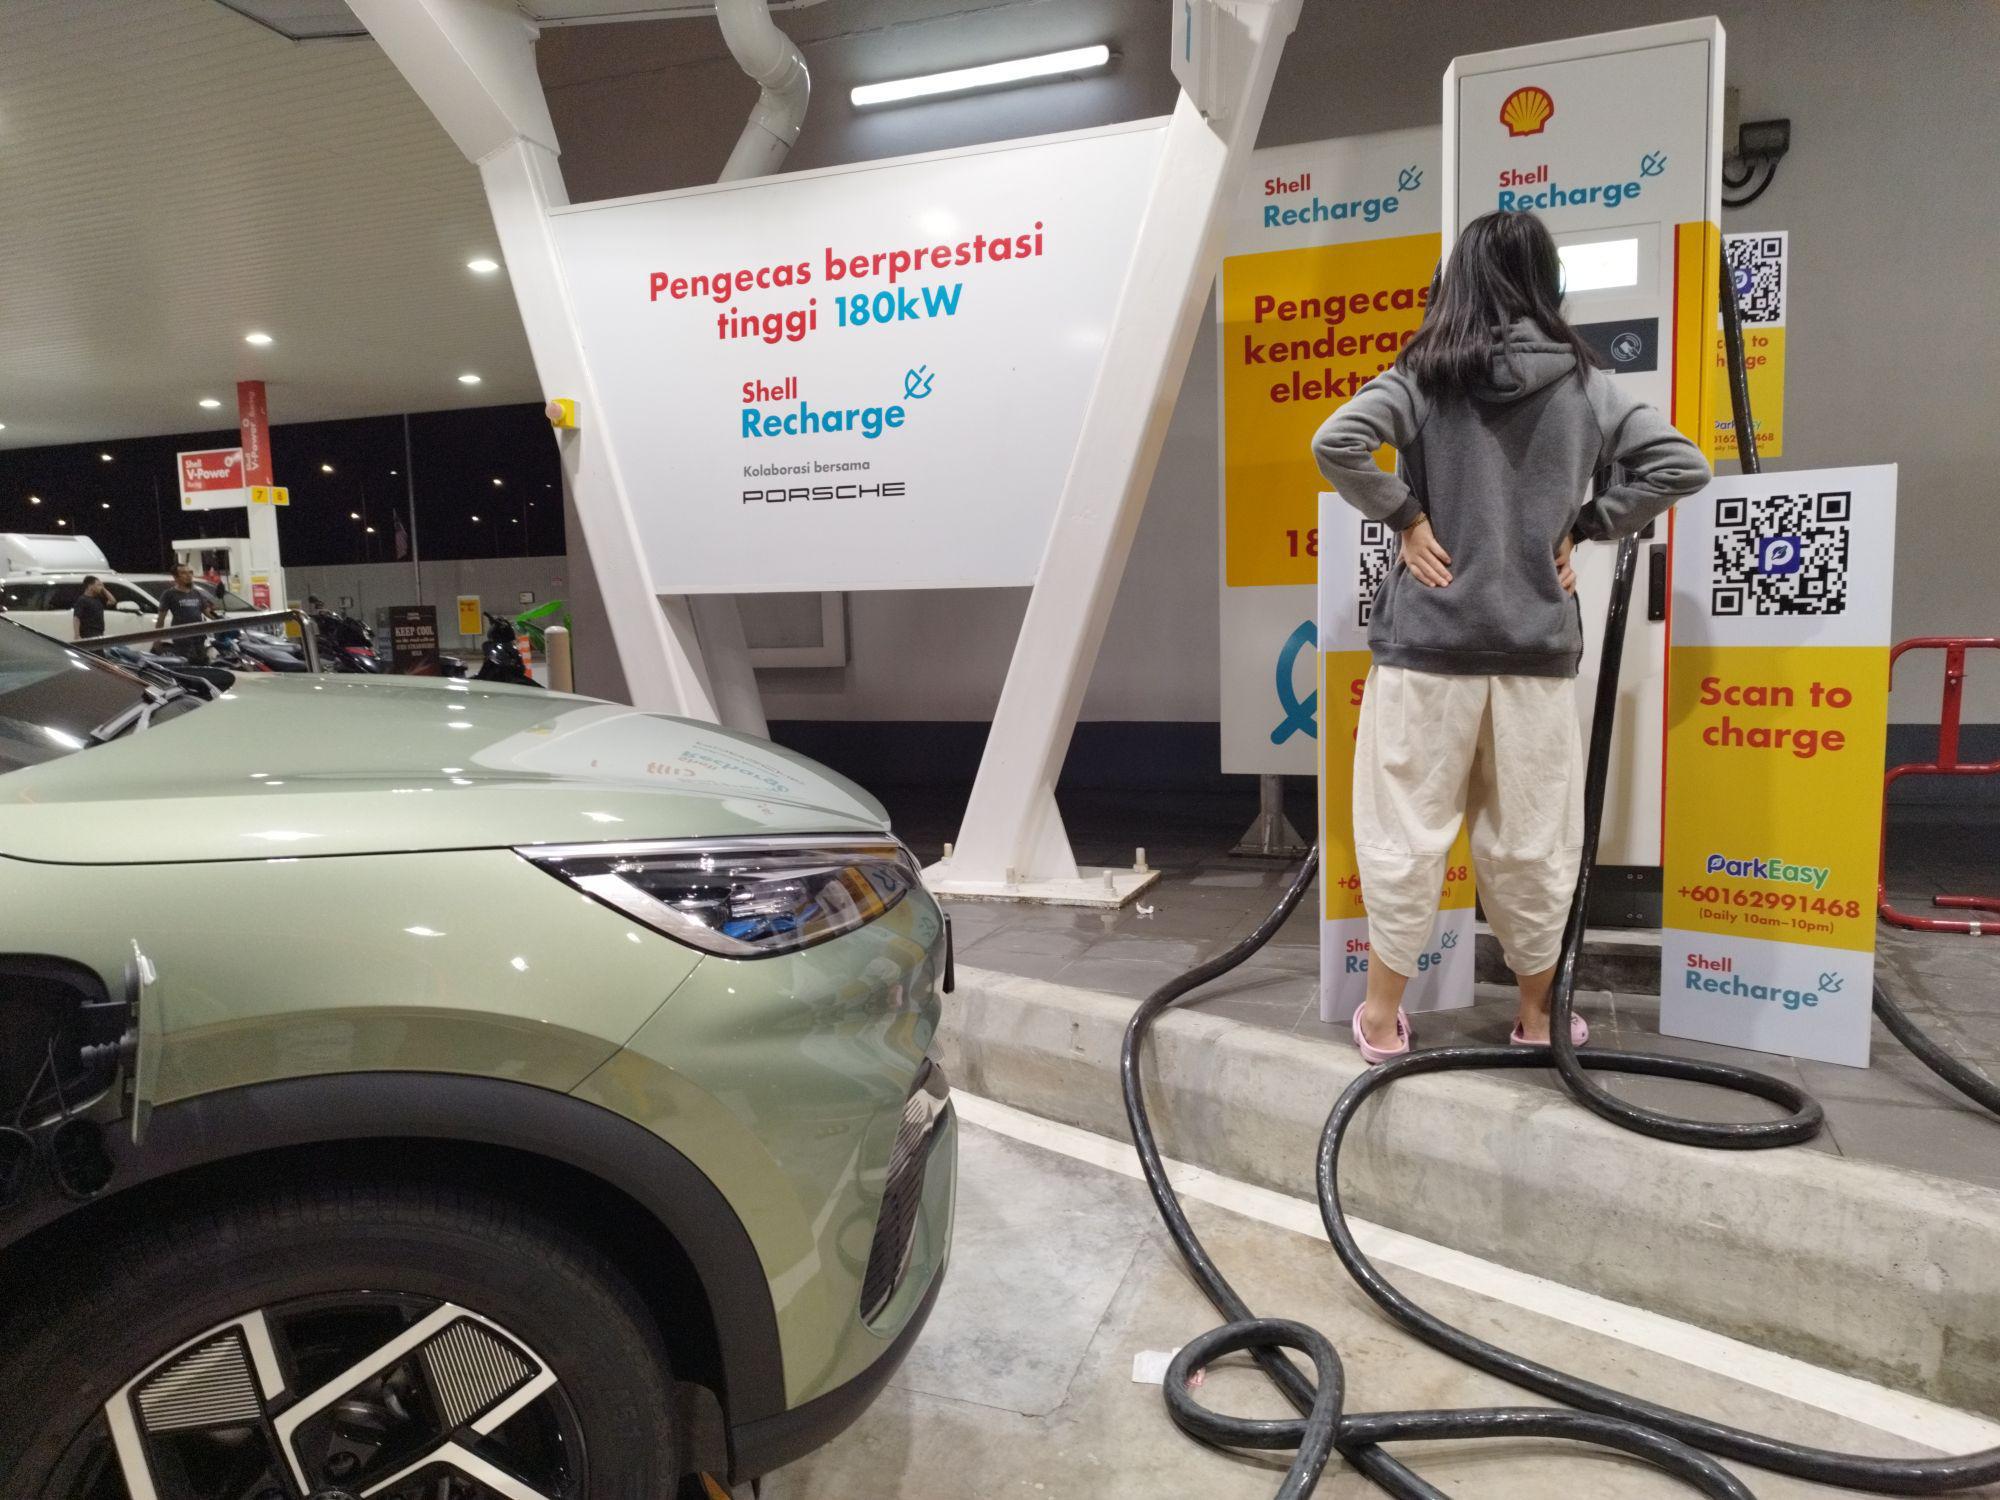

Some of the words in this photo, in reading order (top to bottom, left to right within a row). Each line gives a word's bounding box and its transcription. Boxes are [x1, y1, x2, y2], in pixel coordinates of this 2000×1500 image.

[1264, 173, 1311, 196] Shell
[1499, 165, 1548, 187] Shell
[1498, 182, 1641, 212] Recharge
[1264, 196, 1399, 228] Recharge
[650, 261, 812, 304] Pengecas
[825, 221, 1043, 284] berprestasi
[717, 297, 817, 344] tinggi
[835, 283, 963, 327] 180kW
[1254, 286, 1430, 325] Pengecas
[1752, 336, 1768, 347] to
[742, 376, 798, 404] Shell
[742, 401, 906, 439] Recharge
[185, 459, 202, 469] Shell
[186, 469, 230, 480] V-Power
[743, 462, 810, 478] Kolaborasi
[814, 460, 871, 474] bersama
[256, 490, 263, 499] 7
[743, 482, 906, 504] PORSCHE
[395, 627, 415, 637] KEEP
[416, 626, 434, 636] COOL
[1700, 676, 1794, 706] Scan
[1809, 682, 1853, 708] to
[1702, 716, 1846, 759] charge
[1707, 854, 1829, 890] ParkEasy
[1678, 885, 1861, 919] +60162991468
[1699, 907, 1738, 924] (Daily
[1346, 939, 1370, 953] She
[1687, 954, 1732, 973] Shell
[1685, 970, 1819, 1011] Recharge
